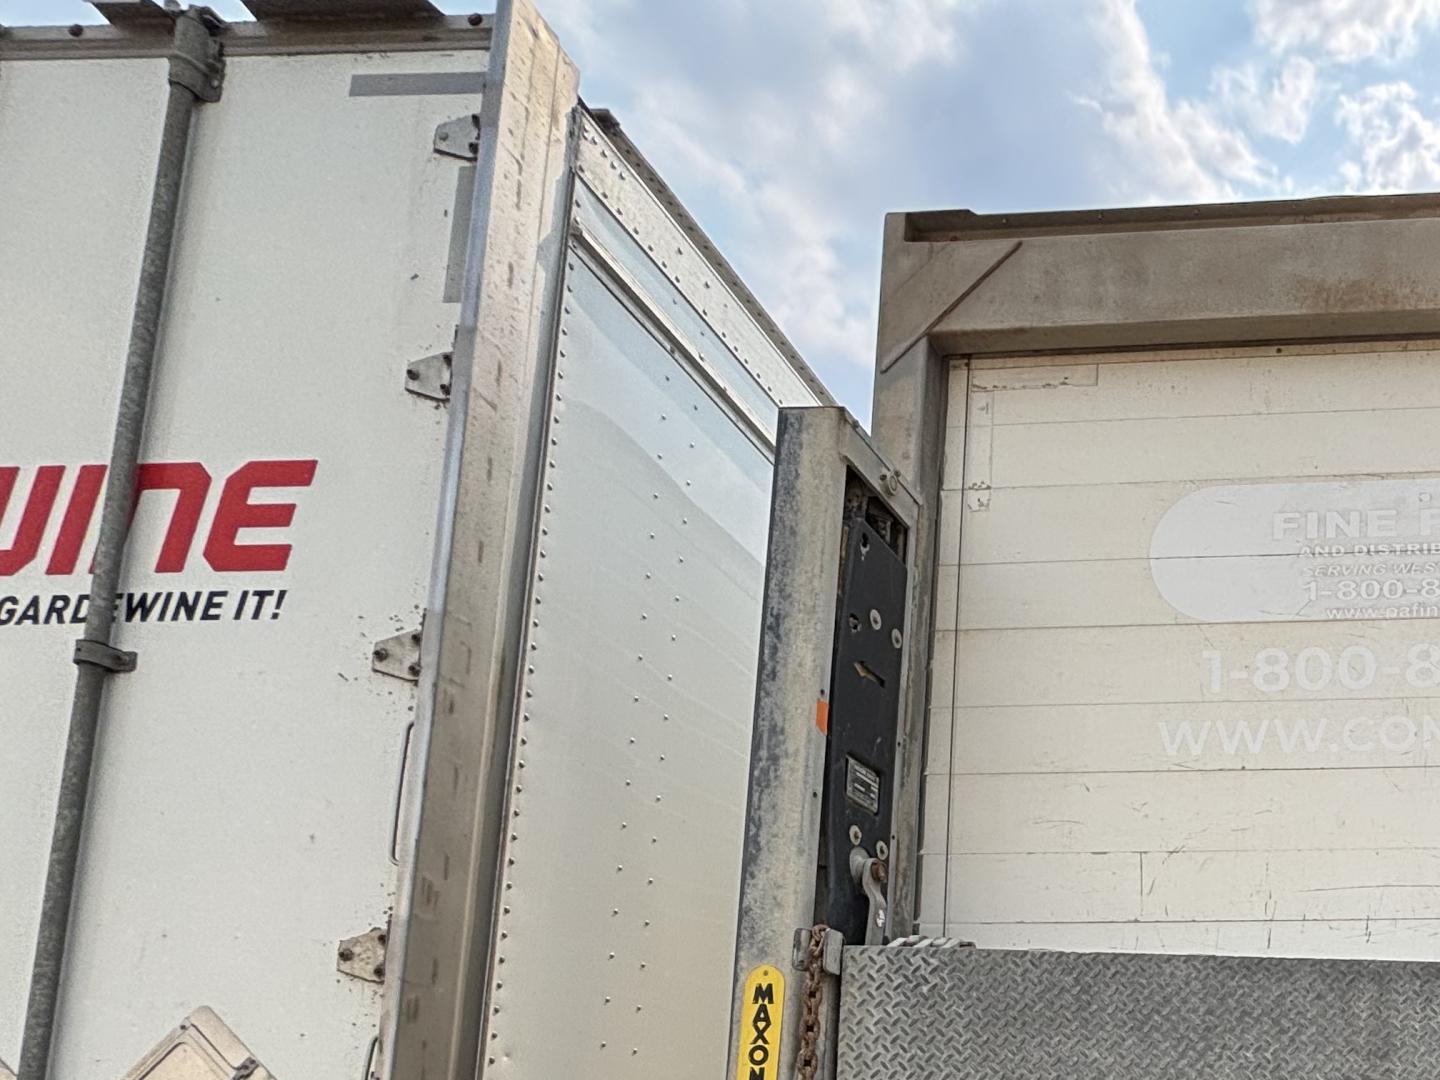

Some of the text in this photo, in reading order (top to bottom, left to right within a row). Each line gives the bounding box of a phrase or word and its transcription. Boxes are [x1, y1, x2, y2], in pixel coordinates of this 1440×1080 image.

[1272, 508, 1398, 540] FINE
[1301, 544, 1344, 558] AND
[1303, 562, 1386, 577] SERVING
[0, 589, 288, 626] GARDWINE IT!
